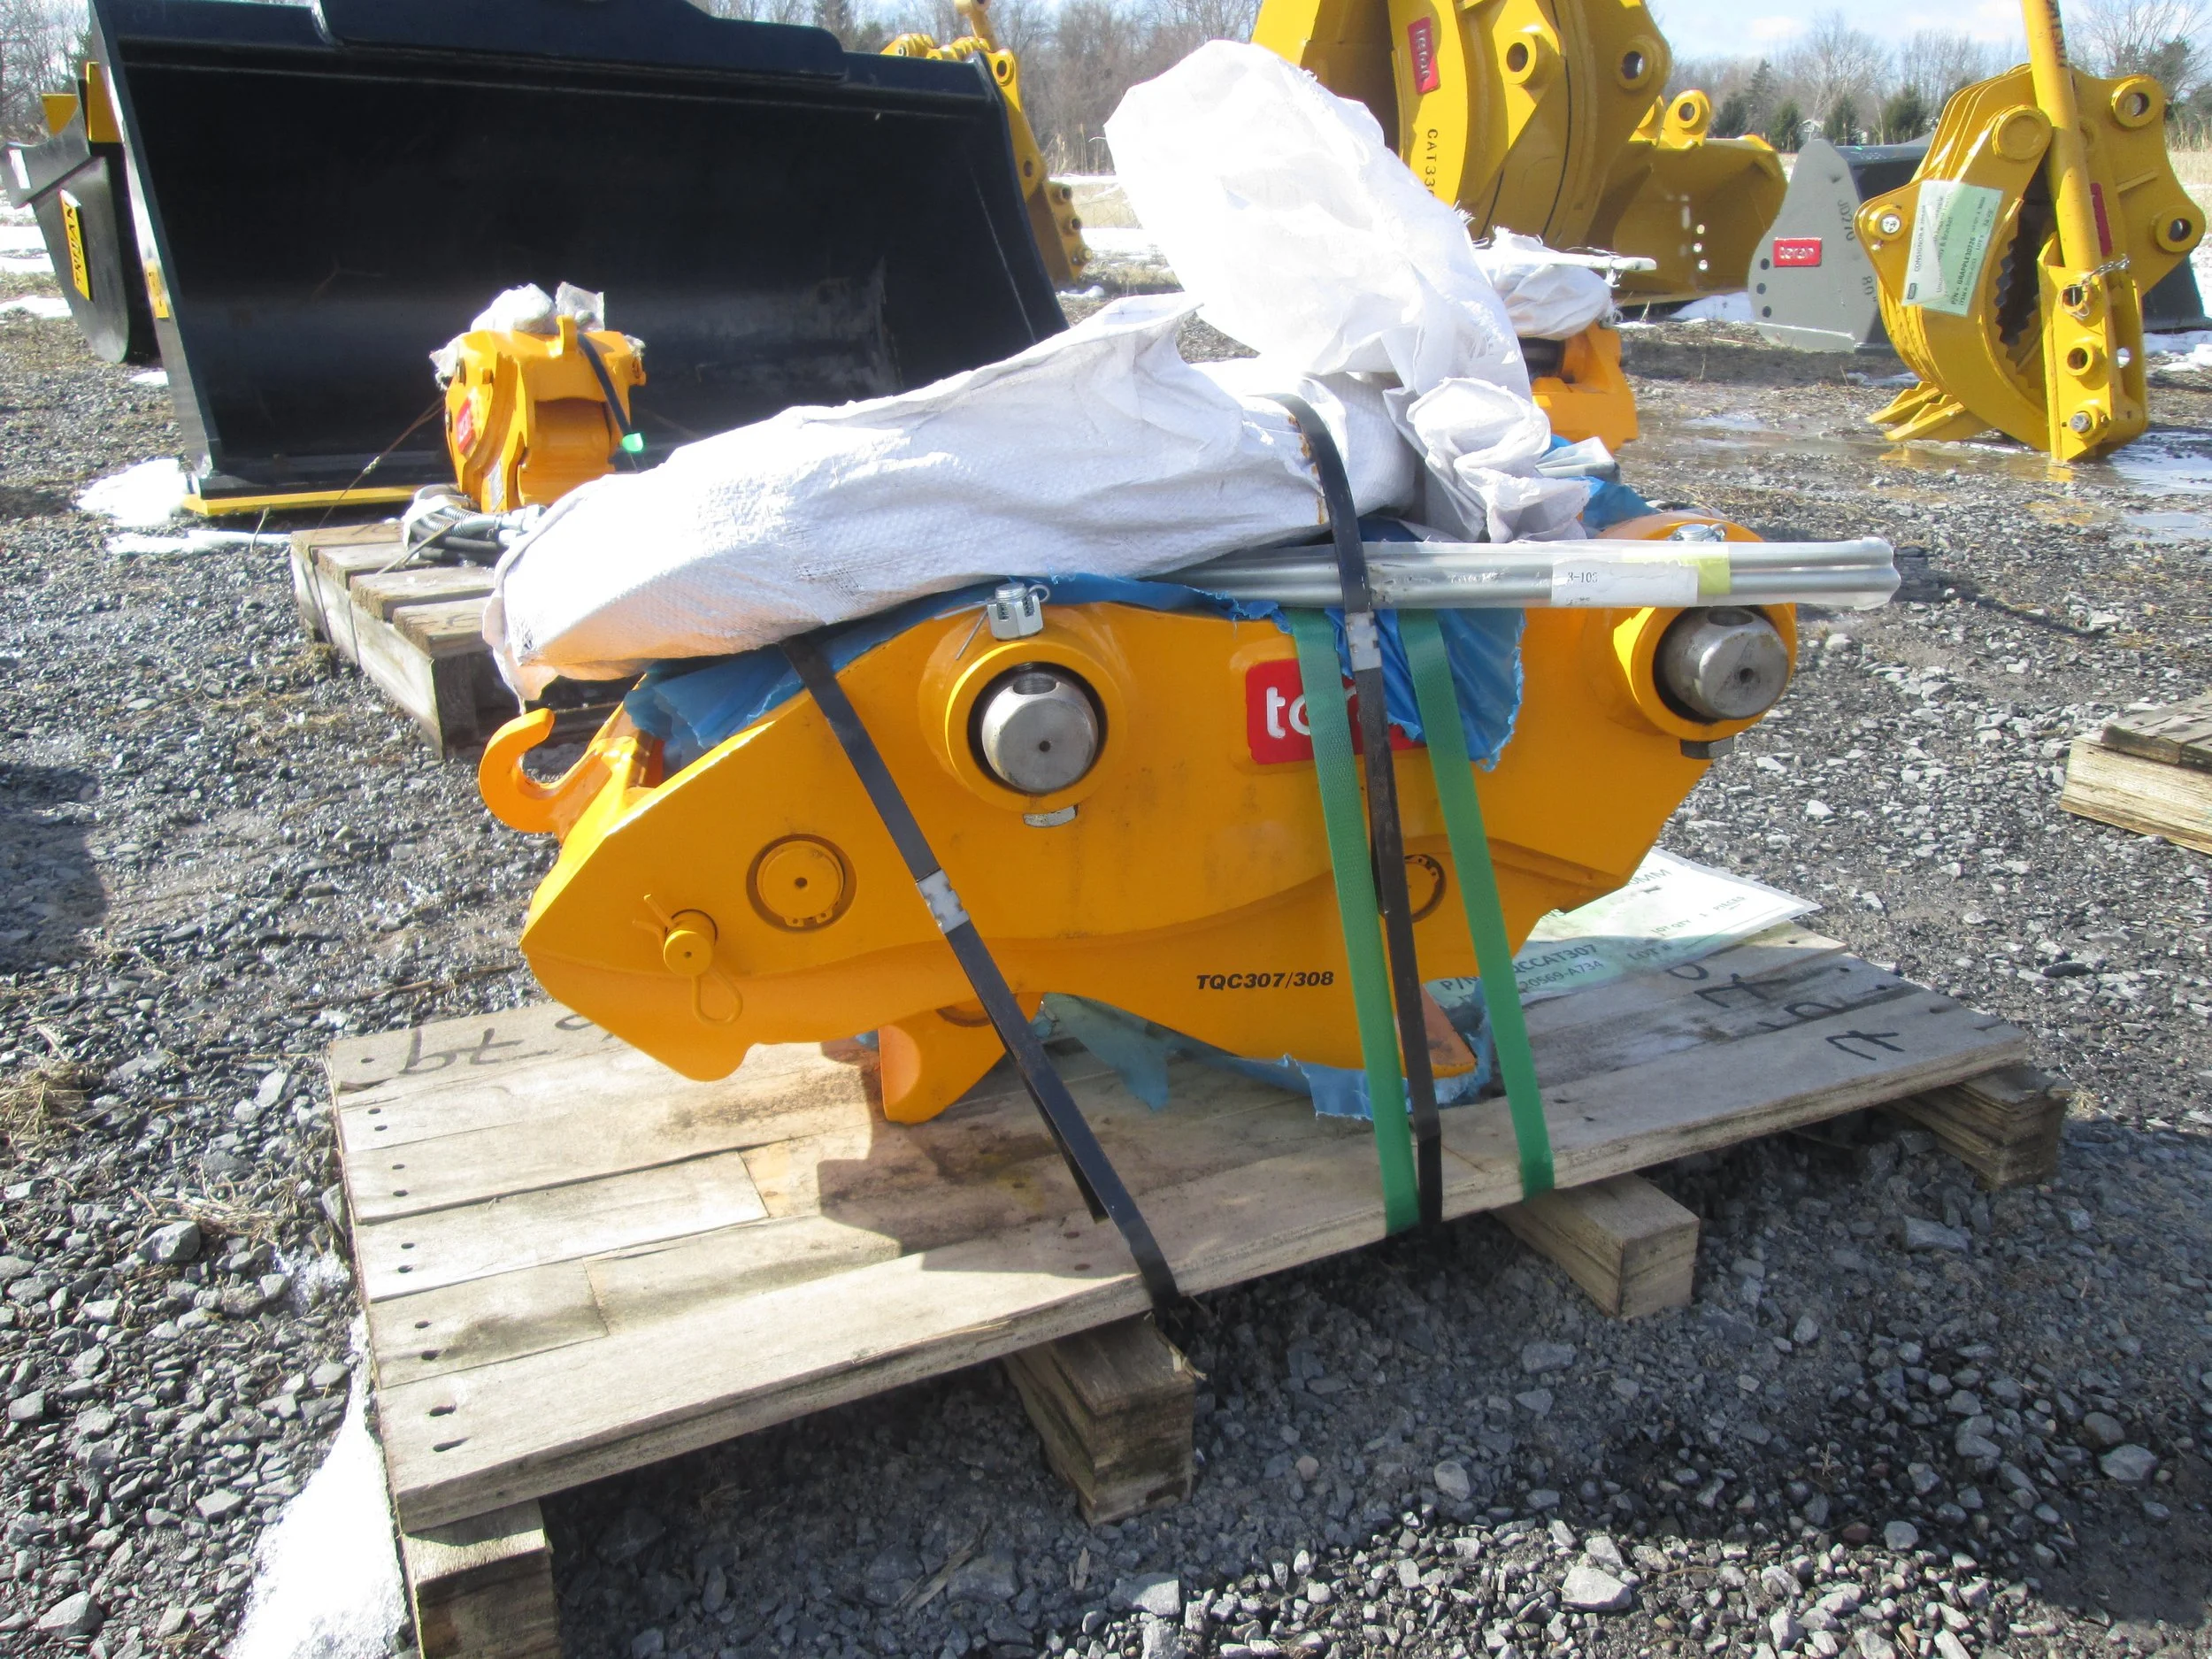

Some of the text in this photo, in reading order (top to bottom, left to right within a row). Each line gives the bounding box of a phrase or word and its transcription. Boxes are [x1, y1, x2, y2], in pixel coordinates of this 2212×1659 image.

[1425, 128, 1439, 196] CAT33
[1514, 943, 1598, 973] QCCAT307
[1196, 972, 1334, 991] TQC307/308
